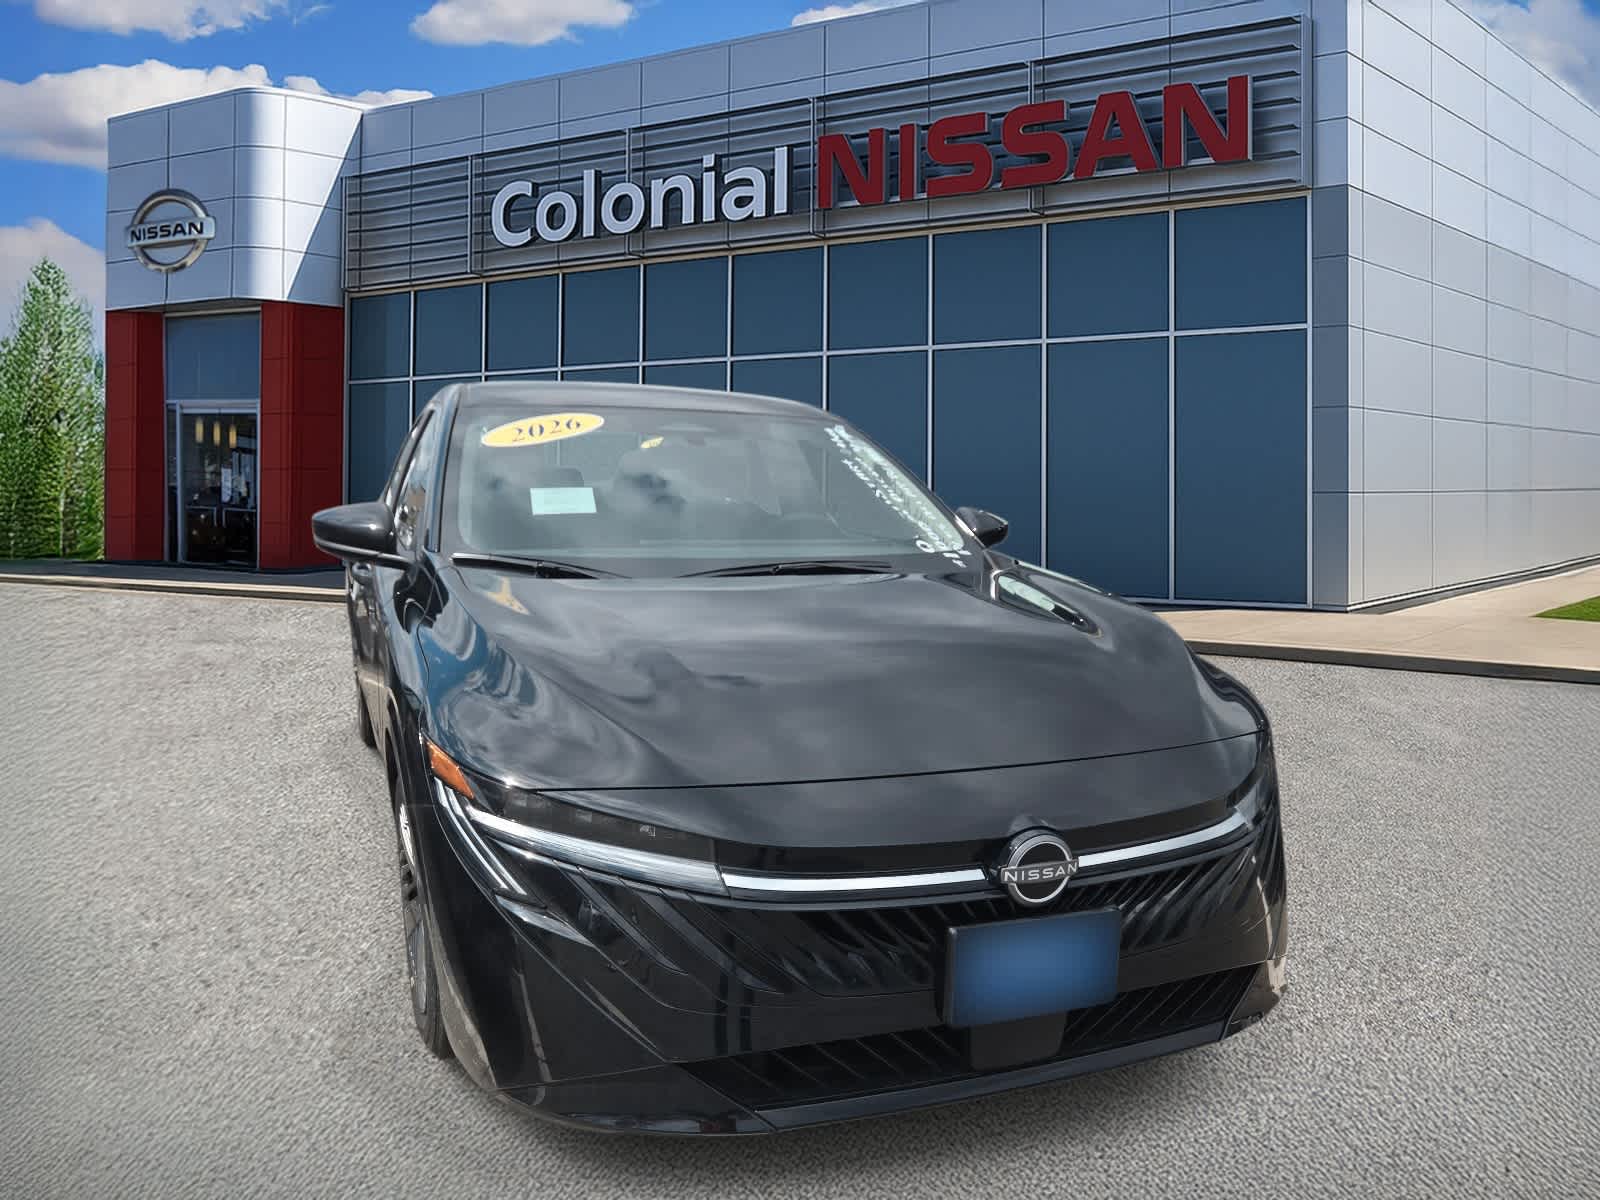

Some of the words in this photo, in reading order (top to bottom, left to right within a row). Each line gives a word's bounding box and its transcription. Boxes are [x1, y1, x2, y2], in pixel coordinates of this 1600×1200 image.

[491, 145, 790, 248] Colonial
[817, 75, 1252, 209] NISSAN
[130, 221, 204, 242] NISSAN
[512, 418, 581, 442] 2026
[1004, 861, 1077, 882] NISSAN
